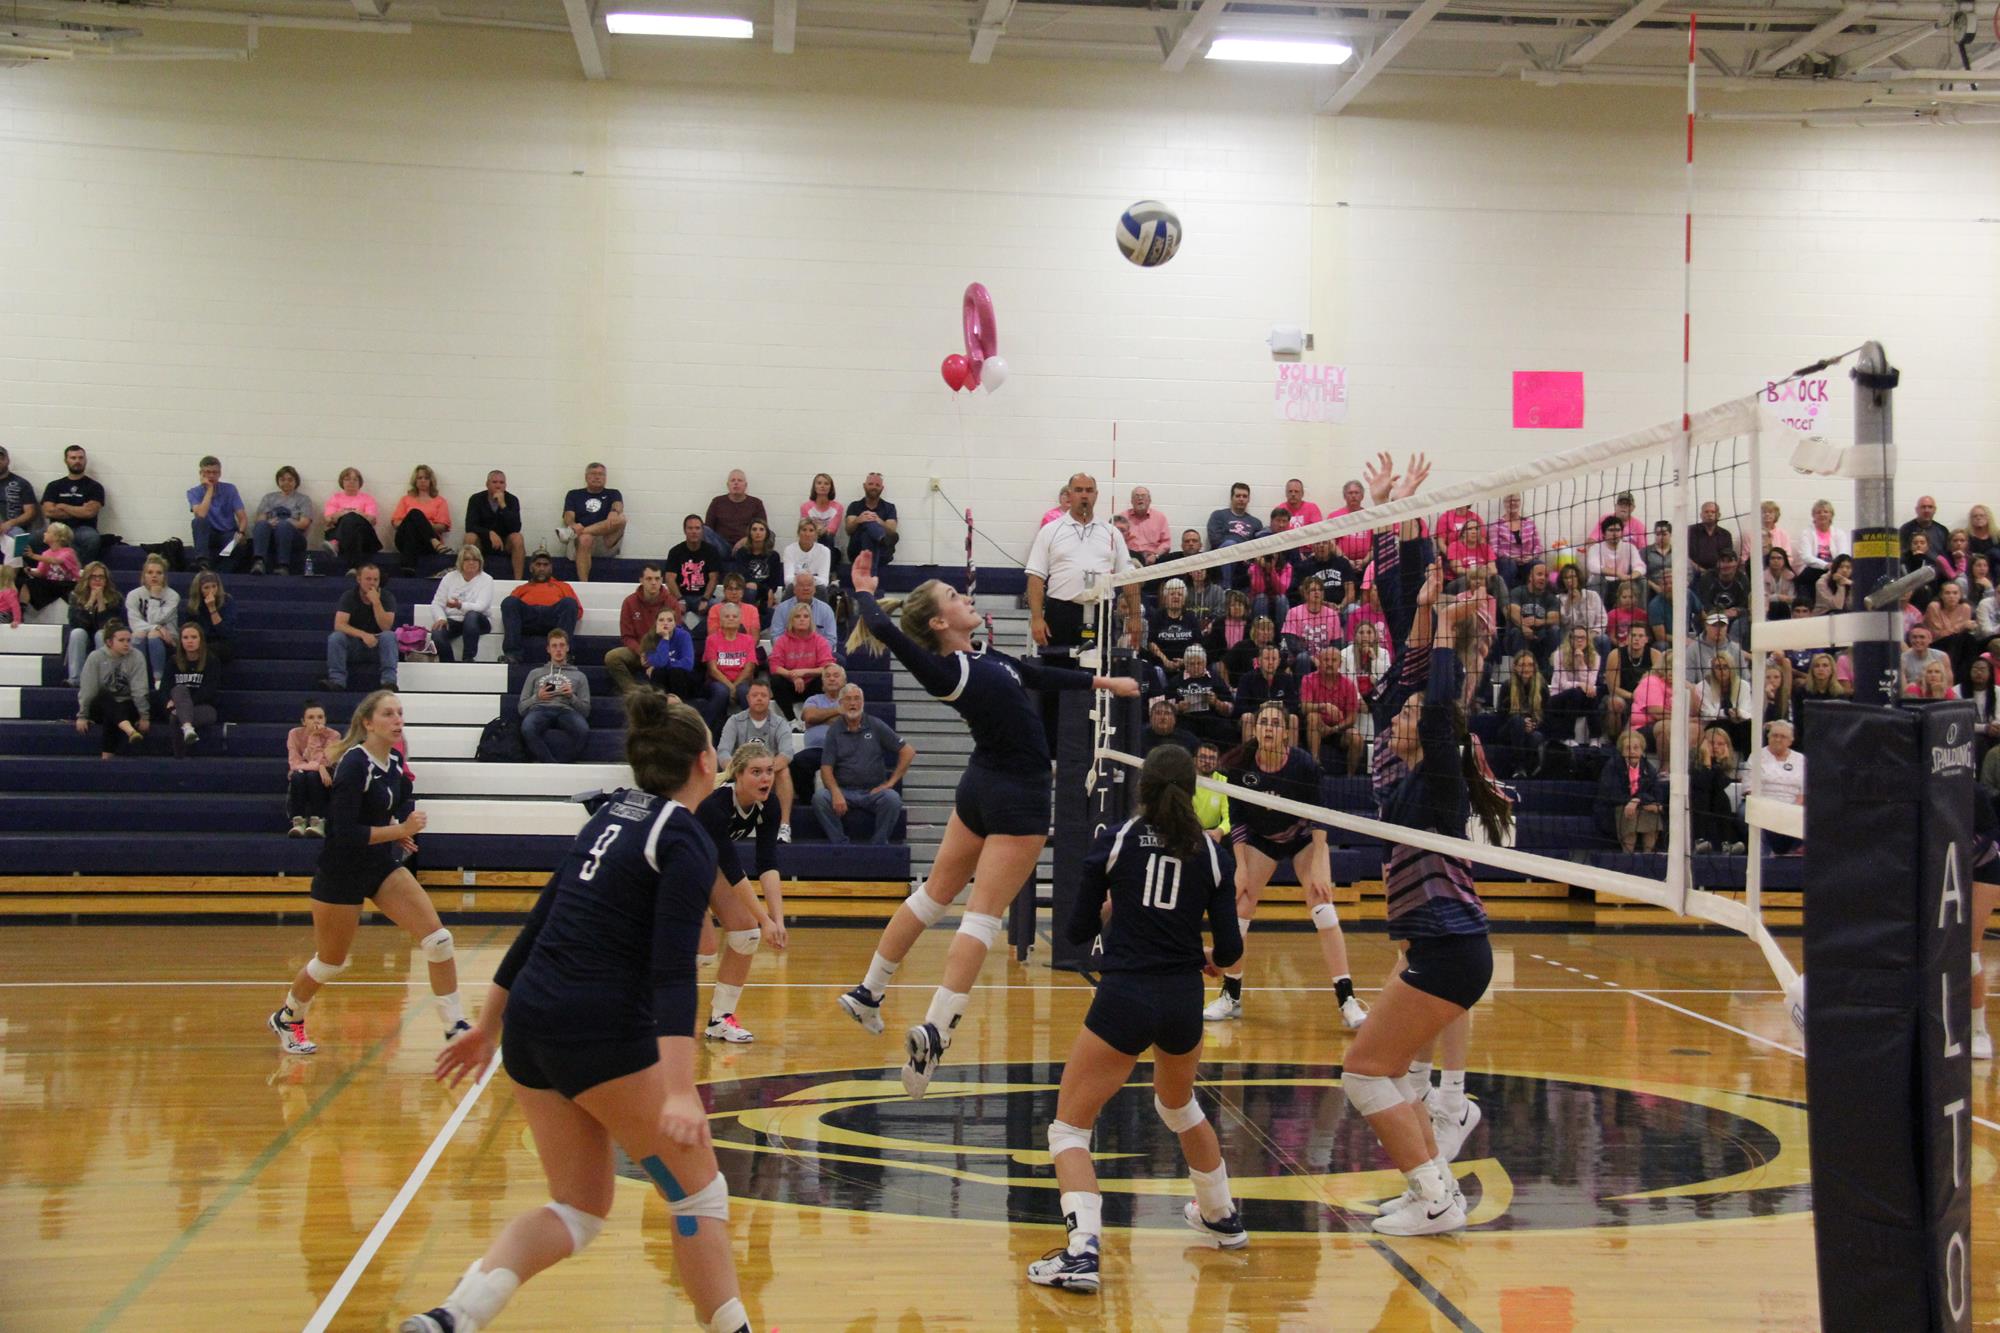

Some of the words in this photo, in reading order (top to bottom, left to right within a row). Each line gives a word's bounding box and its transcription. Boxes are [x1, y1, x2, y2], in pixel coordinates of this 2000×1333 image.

[1931, 741, 1972, 774] SPALDING
[579, 824, 622, 881] 9
[1142, 853, 1182, 910] 10
